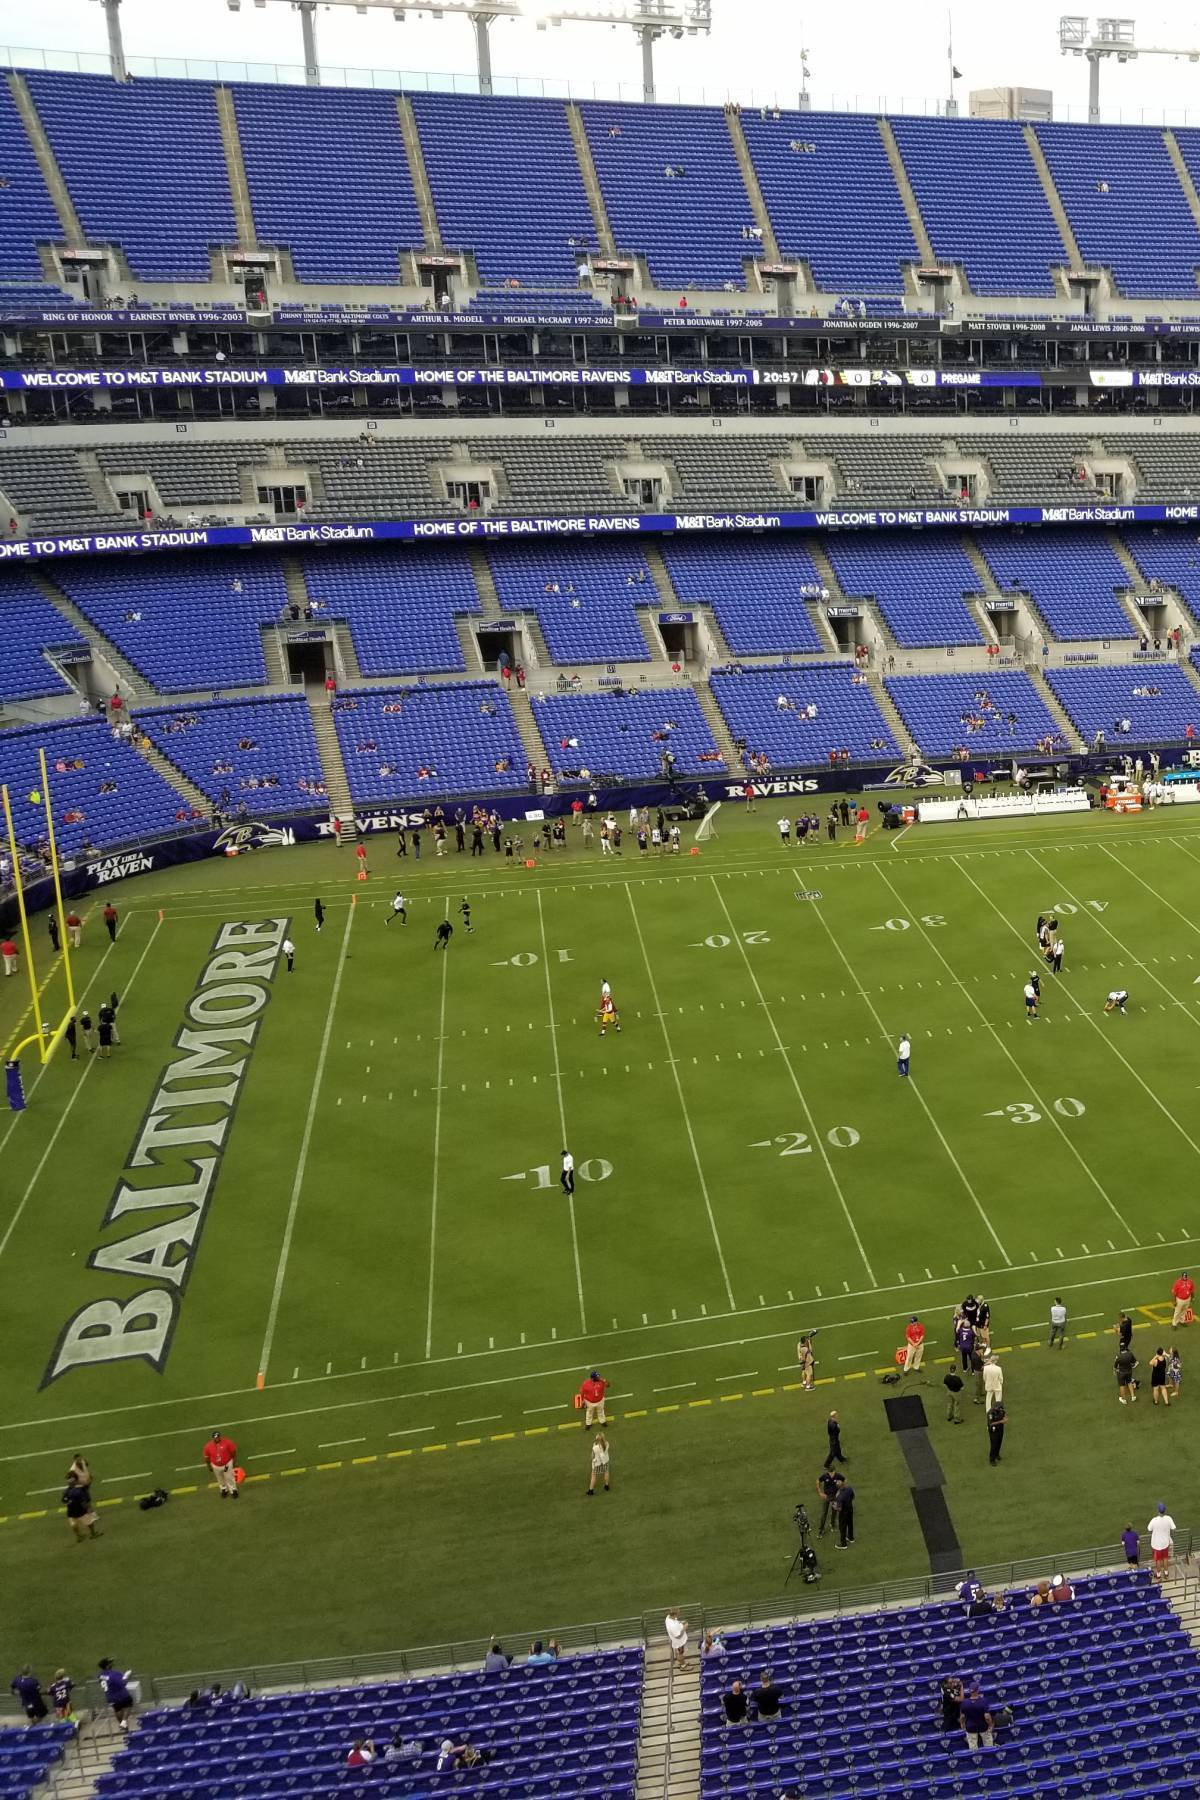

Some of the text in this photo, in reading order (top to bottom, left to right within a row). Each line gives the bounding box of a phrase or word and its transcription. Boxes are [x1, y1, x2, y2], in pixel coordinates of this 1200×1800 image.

[43, 313, 62, 321] RING
[65, 313, 78, 321] OF
[81, 313, 113, 321] HONOR
[130, 313, 243, 322] EARNEST BYNER 1996-2003
[411, 315, 484, 323] ARTHUR B. MODELL
[504, 316, 536, 324] MICHAEL
[574, 317, 612, 325] 1997-2002
[663, 319, 763, 327] PETER BOULWARE 1997-2005
[823, 321, 918, 329] JONATHAN OGDEN 1996-2007
[22, 371, 267, 386] WELCOME TO M&T BANK STADIUM
[284, 371, 400, 384] M&T Bank Stadium
[415, 371, 631, 383] HOME OF THE BALTIMORE RAVENS
[645, 370, 747, 383] M&T Bank Stadium
[763, 372, 798, 383] 20:57
[941, 374, 981, 384] PREGAME
[1139, 373, 1164, 385] M&T
[1164, 373, 1187, 385] Bank
[816, 511, 1009, 525] WELCOME TO M&T BANK STADIUM
[1042, 509, 1135, 520] M&T Bank Stadium
[1166, 507, 1197, 518] HOME
[414, 518, 640, 536] HOME OF THE BALTIMORE RAVENS
[676, 516, 780, 528] M&T Bank Stadium
[250, 526, 373, 543] M&T Bank Stadium
[32, 541, 56, 554] TO
[58, 540, 91, 552] M&T
[96, 536, 138, 550] BANK
[142, 532, 207, 548] STADIUM
[743, 775, 802, 783] BALTIMORE
[724, 779, 819, 797] RAVENS
[86, 856, 120, 875] PLAY
[97, 857, 154, 883] RAVEN
[1052, 900, 1110, 916] 40
[885, 914, 949, 931] 30
[705, 930, 772, 948] 20
[510, 948, 575, 967] 10
[1004, 1097, 1086, 1124] 30
[774, 1126, 861, 1156] 20
[38, 917, 292, 1393] BALTIMORE
[529, 1158, 614, 1190] 10
